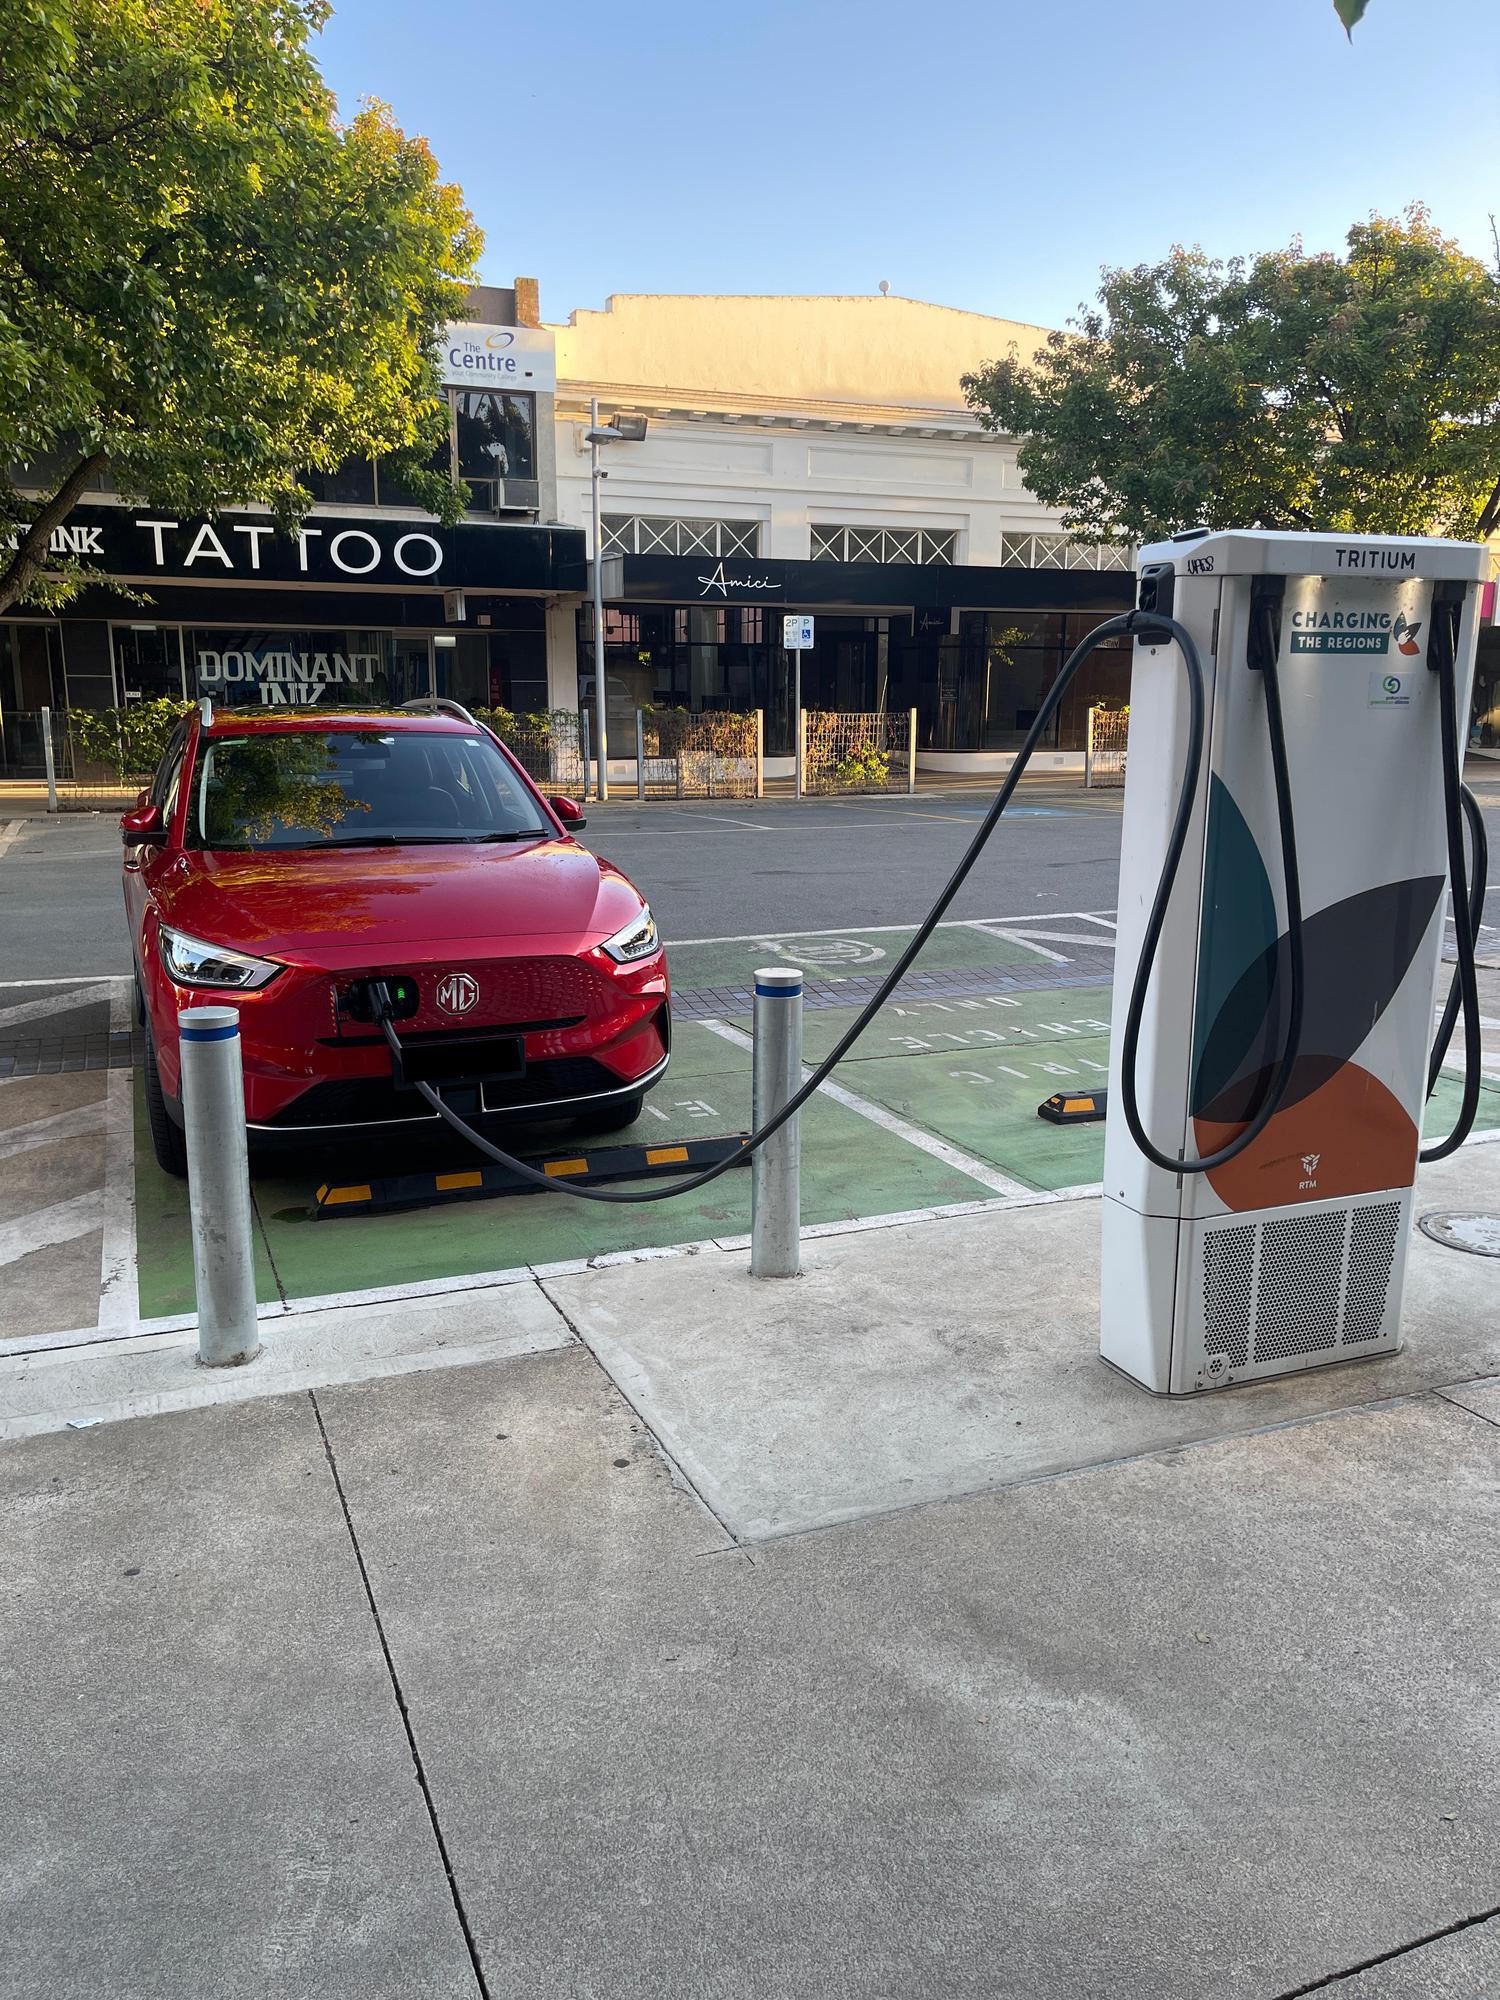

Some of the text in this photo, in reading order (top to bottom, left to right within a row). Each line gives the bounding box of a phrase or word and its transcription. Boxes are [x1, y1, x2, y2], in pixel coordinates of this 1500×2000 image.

[464, 342, 481, 353] The
[449, 348, 516, 373] Centre
[50, 525, 104, 554] INK
[135, 520, 443, 576] TATTOO
[1336, 549, 1416, 570] TRITIUM
[697, 561, 782, 597] Amici
[785, 619, 797, 627] 2P
[803, 619, 810, 627] P
[1291, 611, 1391, 629] CHARGING
[1298, 636, 1382, 649] THE REGIONS
[198, 651, 379, 683] DOMINANT
[258, 682, 326, 705] INK
[440, 977, 476, 1011] MG
[889, 997, 1023, 1017] ONLY
[888, 1018, 1112, 1049] EHICLE
[1299, 1180, 1317, 1190] RTM
